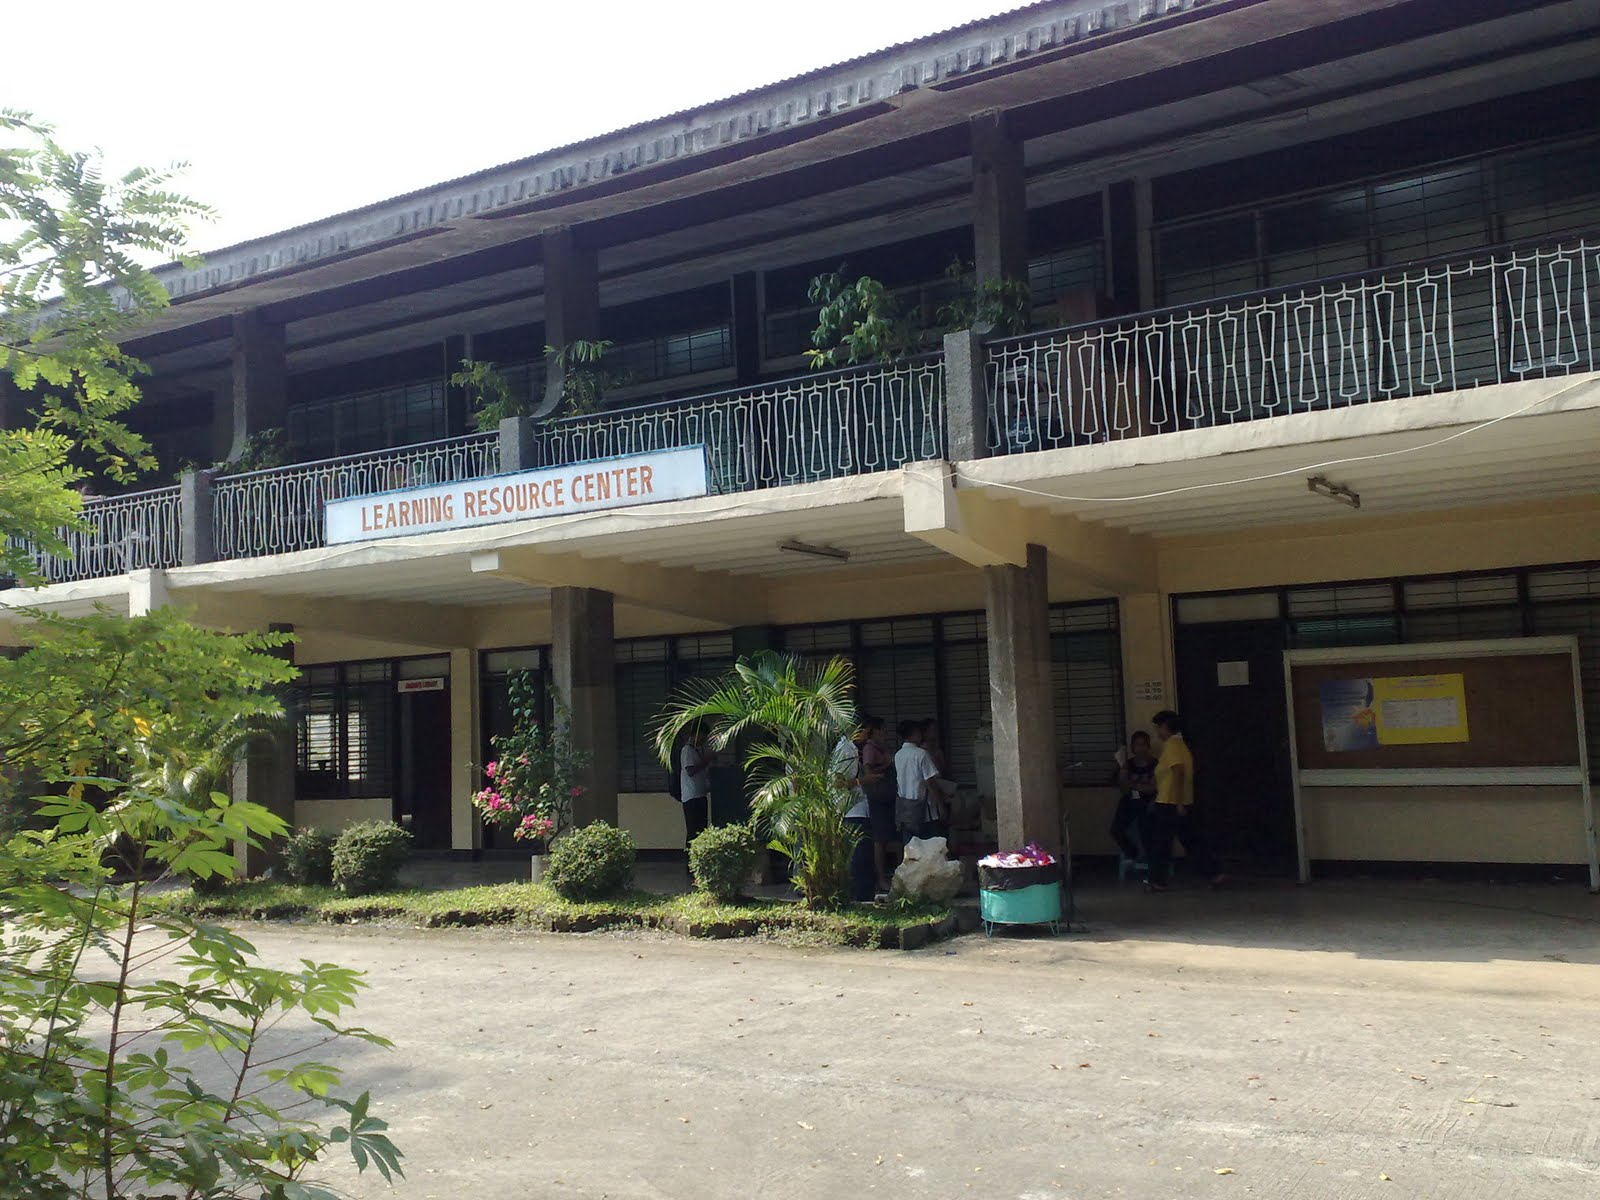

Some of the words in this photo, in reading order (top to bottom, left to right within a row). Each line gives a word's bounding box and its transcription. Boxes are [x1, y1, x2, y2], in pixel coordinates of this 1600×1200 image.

[361, 494, 454, 532] LEARNING
[464, 478, 565, 518] RESOURCE
[571, 465, 654, 503] CENTER
